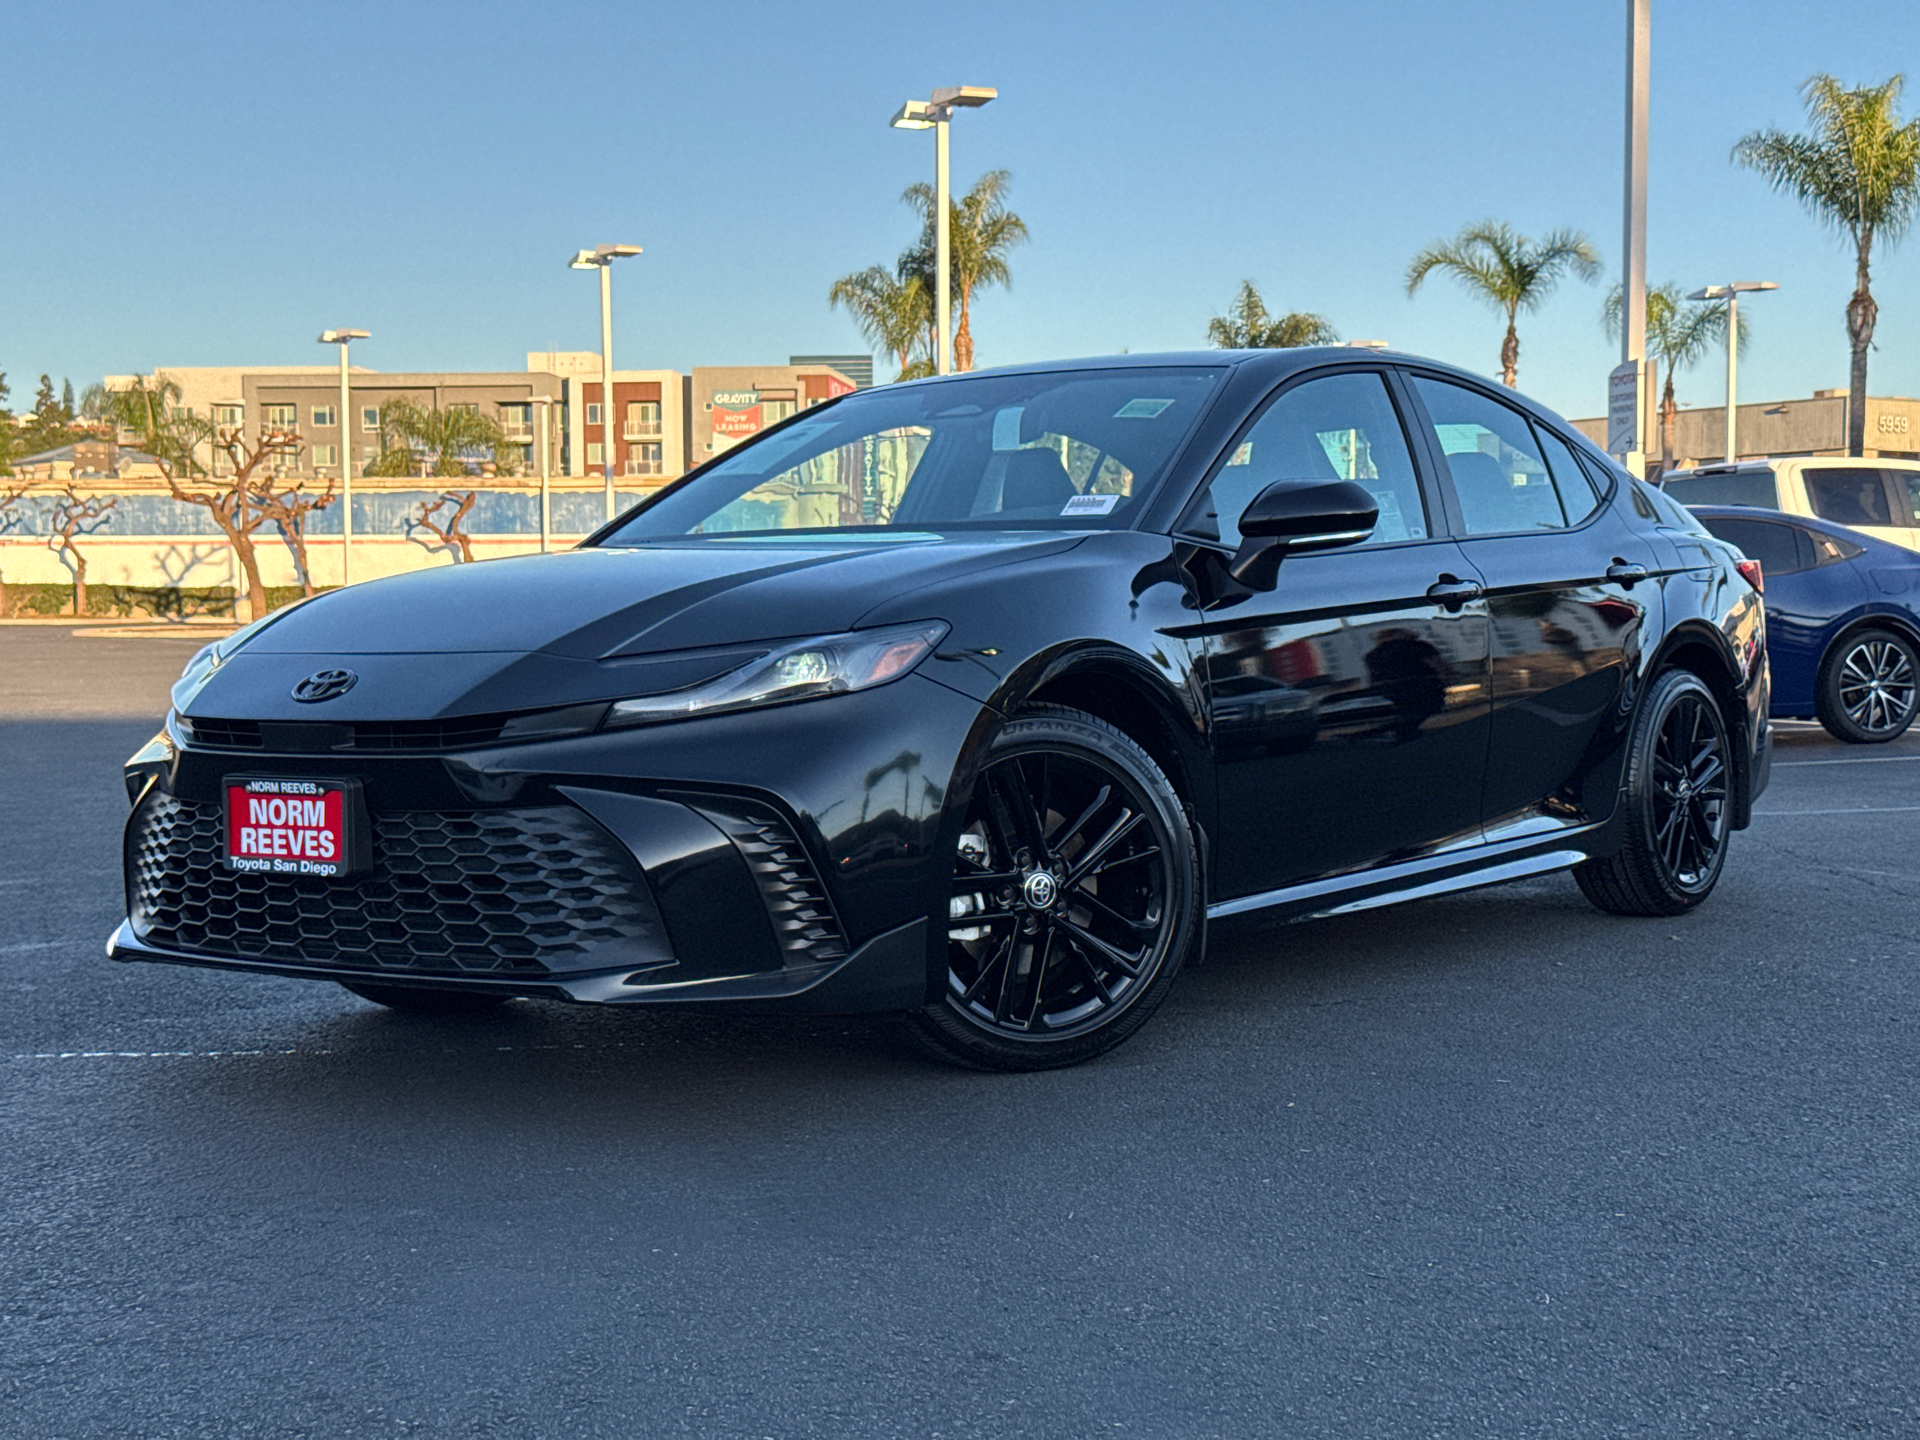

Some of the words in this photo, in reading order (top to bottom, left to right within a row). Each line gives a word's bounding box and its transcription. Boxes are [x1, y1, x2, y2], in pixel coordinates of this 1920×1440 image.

[1610, 373, 1636, 387] TOYOTA
[714, 393, 757, 404] GRAVITY
[1610, 392, 1636, 404] CUSTOMER
[1612, 403, 1634, 413] PARKING
[716, 423, 757, 431] LEASING
[1615, 416, 1629, 426] ONLY
[1878, 415, 1908, 433] 5959
[251, 781, 279, 793] NORM
[281, 782, 317, 794] REEVES
[249, 799, 325, 827] NORM
[240, 827, 335, 858] REEVES
[230, 856, 271, 871] Toyota
[273, 859, 297, 872] San
[300, 861, 336, 877] Diego
